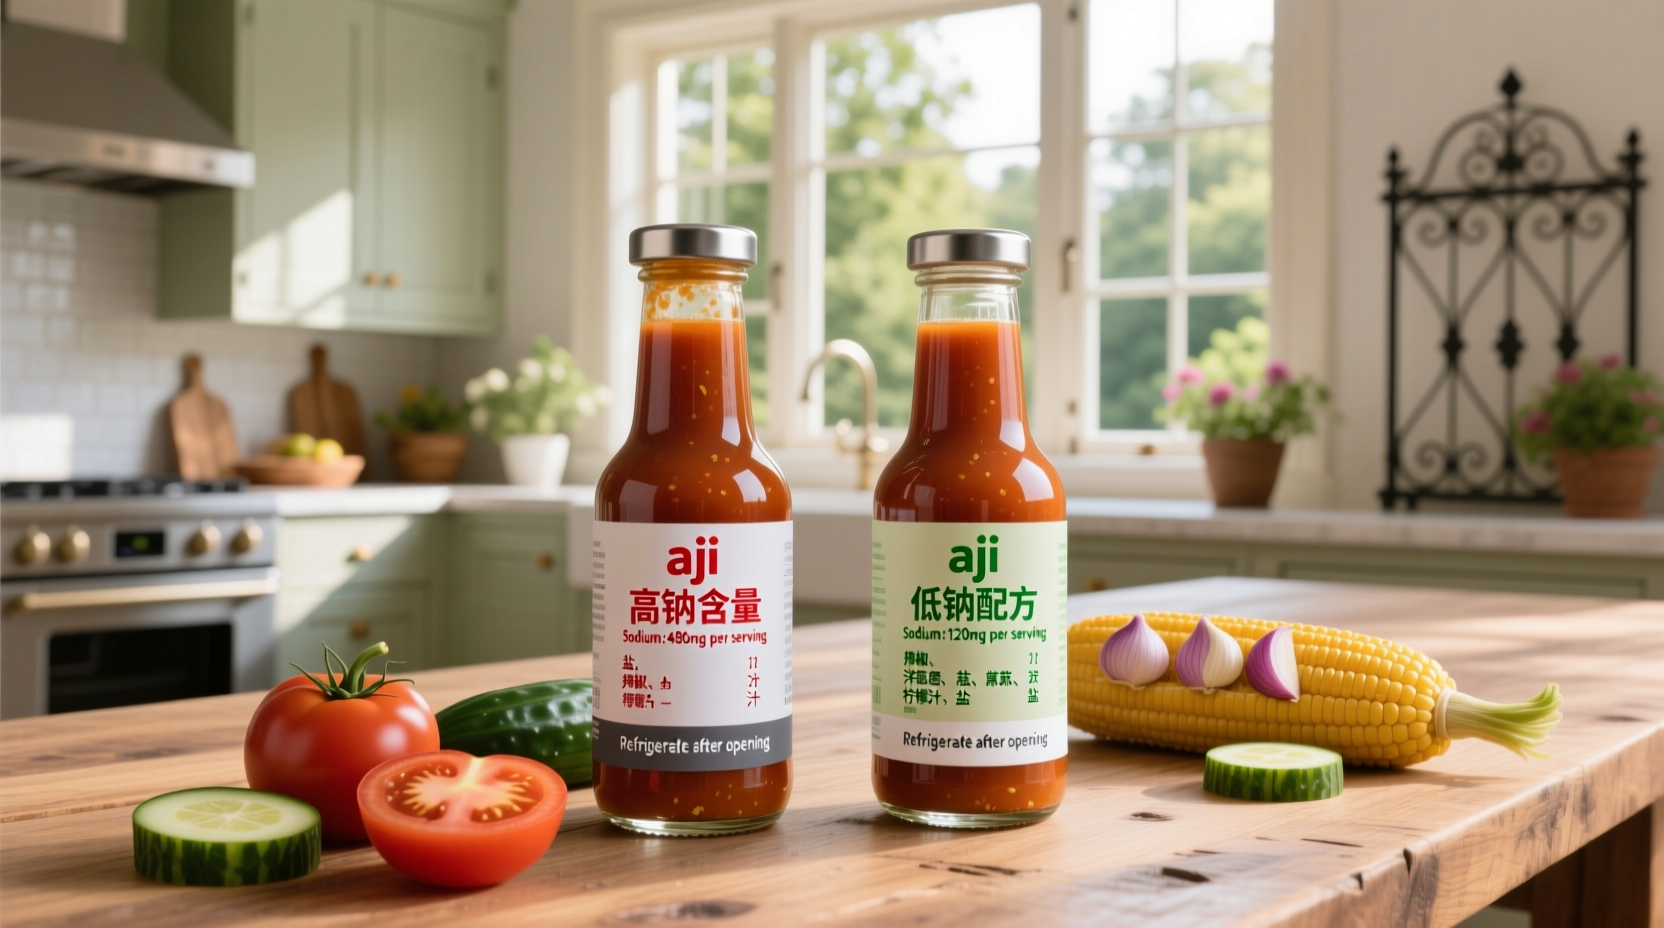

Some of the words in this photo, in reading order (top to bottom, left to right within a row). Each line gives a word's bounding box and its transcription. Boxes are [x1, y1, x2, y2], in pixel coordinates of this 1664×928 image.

[666, 535, 719, 585] aji
[949, 534, 1000, 583] aji
[629, 587, 762, 625] 高钠含量
[911, 585, 1039, 622] 低钠配方
[710, 633, 728, 648] per
[990, 630, 1008, 644] per
[693, 737, 723, 753] after
[726, 735, 770, 756] opening
[903, 731, 973, 752] Refrigerate
[976, 734, 1005, 749] after
